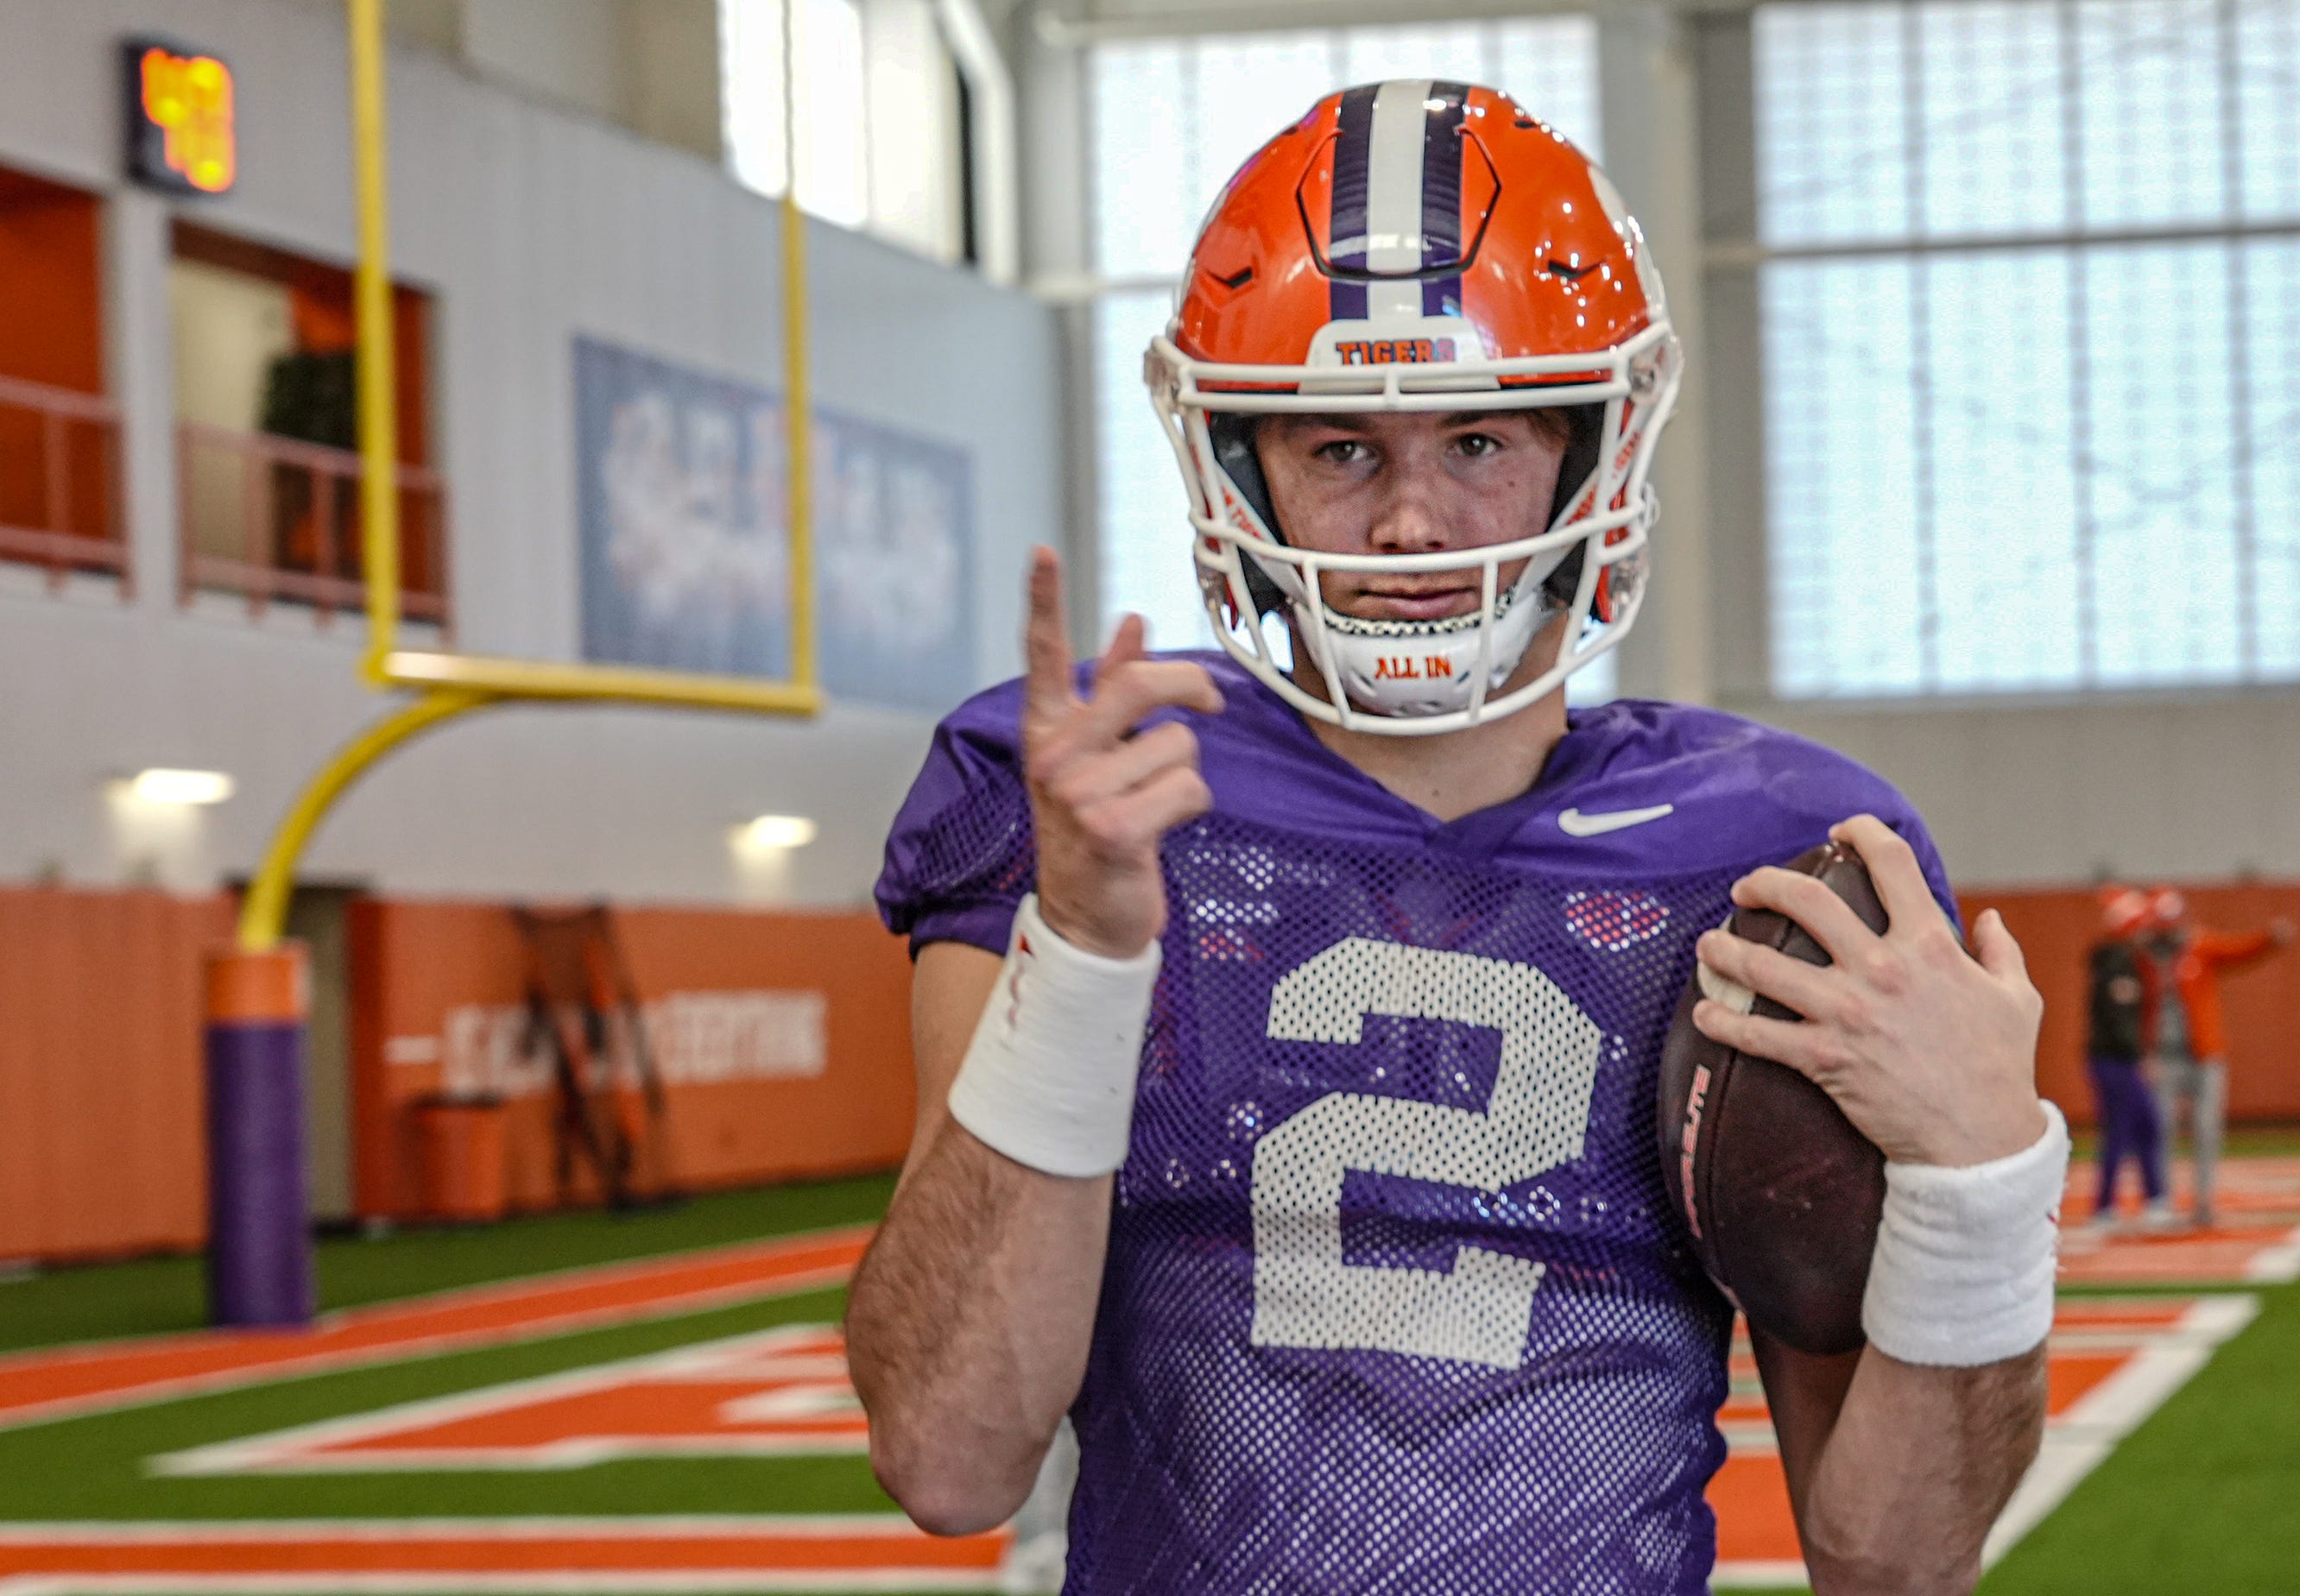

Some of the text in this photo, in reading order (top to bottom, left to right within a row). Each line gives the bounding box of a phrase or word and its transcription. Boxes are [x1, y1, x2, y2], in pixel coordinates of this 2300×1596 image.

[1336, 338, 1456, 366] TIGERS
[1374, 656, 1451, 679] ALL IN
[1250, 937, 1602, 1371] 2
